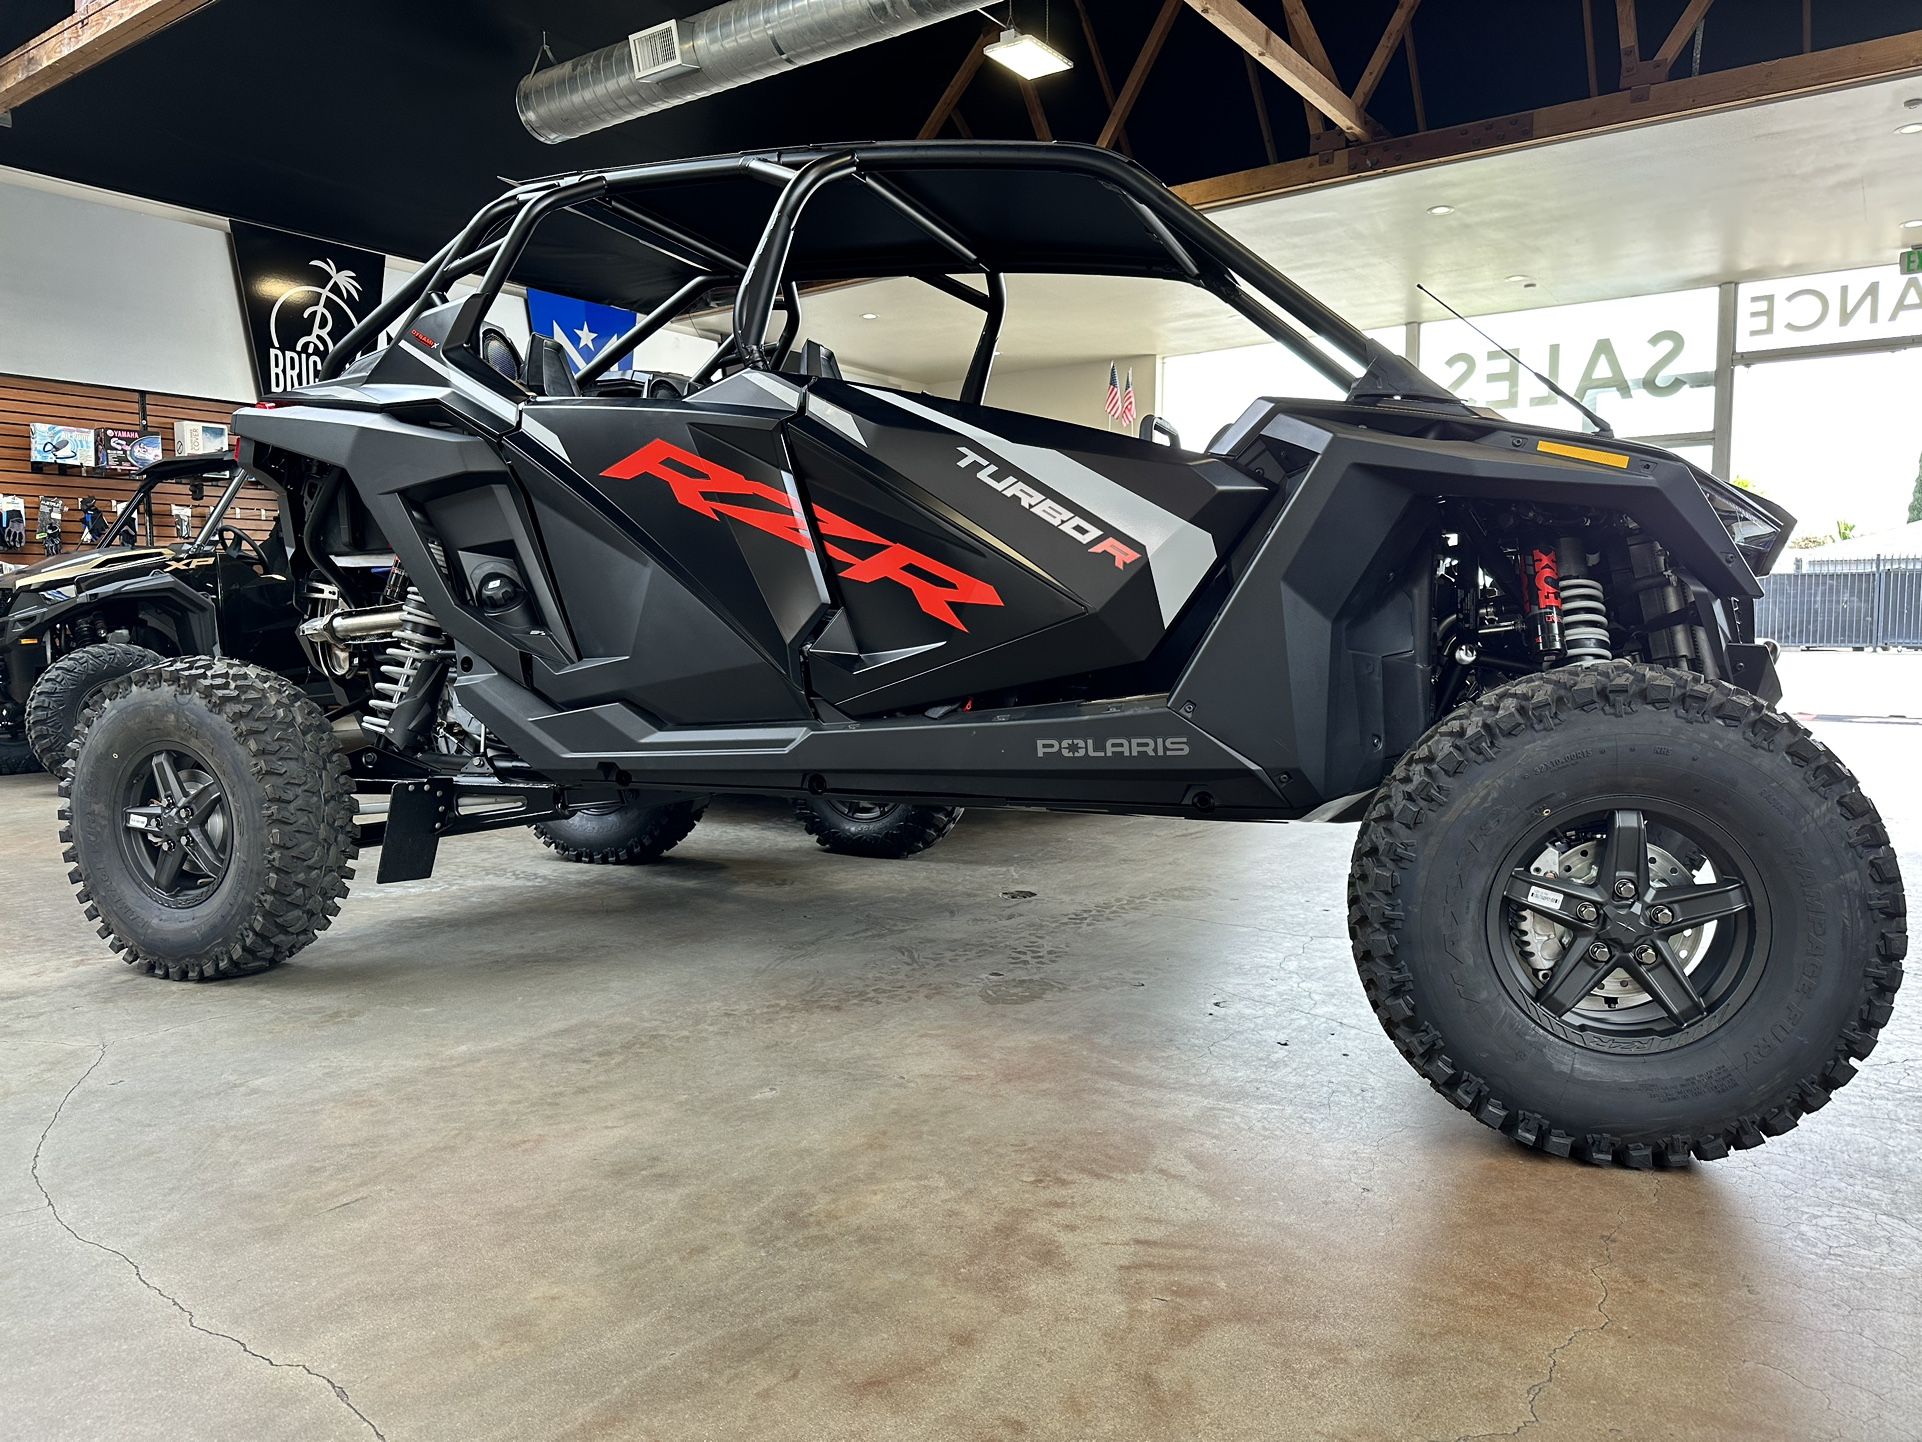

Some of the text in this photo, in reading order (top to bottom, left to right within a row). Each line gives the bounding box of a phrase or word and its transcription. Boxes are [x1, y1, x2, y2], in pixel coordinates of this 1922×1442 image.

[113, 430, 139, 439] YAMAHA
[600, 438, 1005, 633] RZR
[164, 557, 216, 572] XP
[1533, 549, 1562, 609] FOX
[1036, 737, 1191, 758] POLARIS
